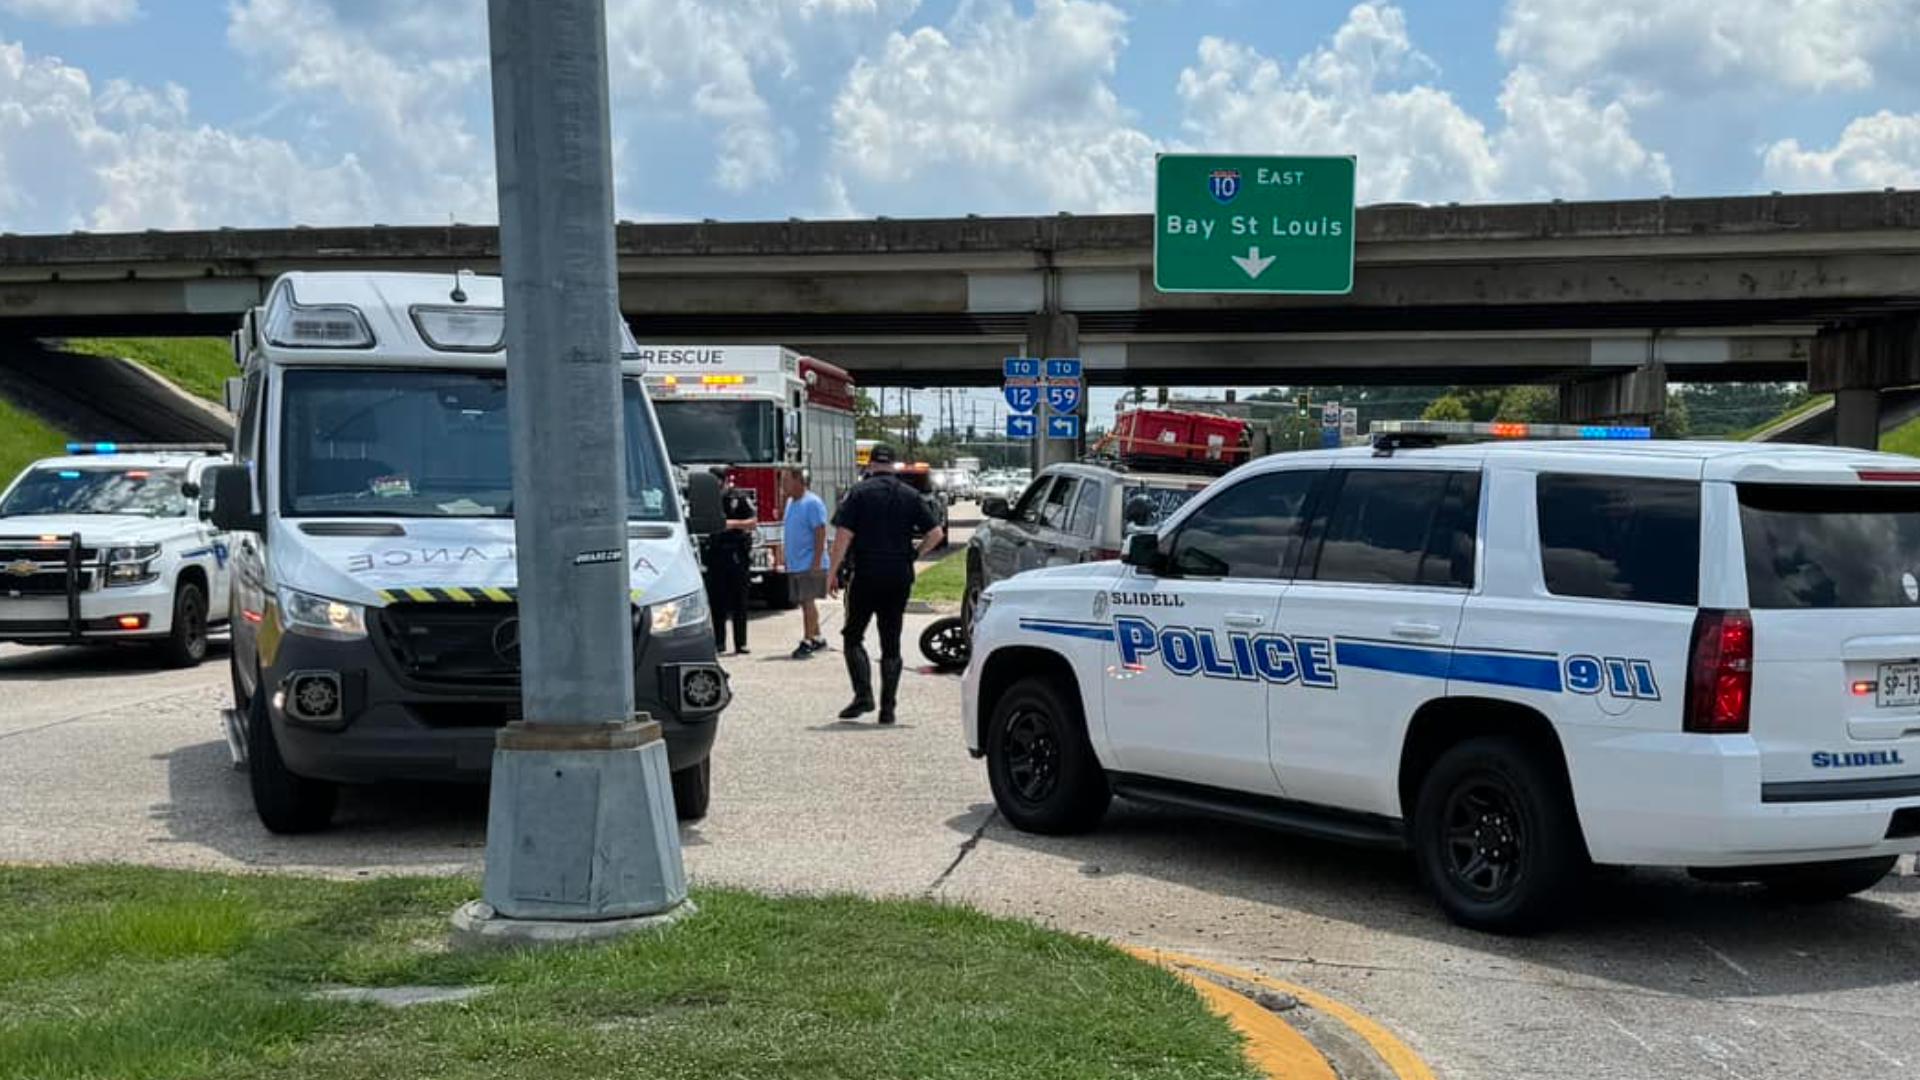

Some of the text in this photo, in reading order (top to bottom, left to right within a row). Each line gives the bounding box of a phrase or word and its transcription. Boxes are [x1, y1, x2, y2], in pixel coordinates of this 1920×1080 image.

[1215, 168, 1304, 197] 10 EAST
[1167, 215, 1342, 239] Bay St Louis
[643, 350, 724, 364] RESCUE
[1014, 362, 1030, 373] TO
[1055, 362, 1072, 373] TO
[1013, 388, 1031, 405] 12
[1052, 388, 1075, 405] 59
[1111, 592, 1185, 607] SLIDELL
[1113, 614, 1338, 689] POLICE
[1564, 655, 1661, 701] 911
[1811, 749, 1904, 768] SLIDELL
